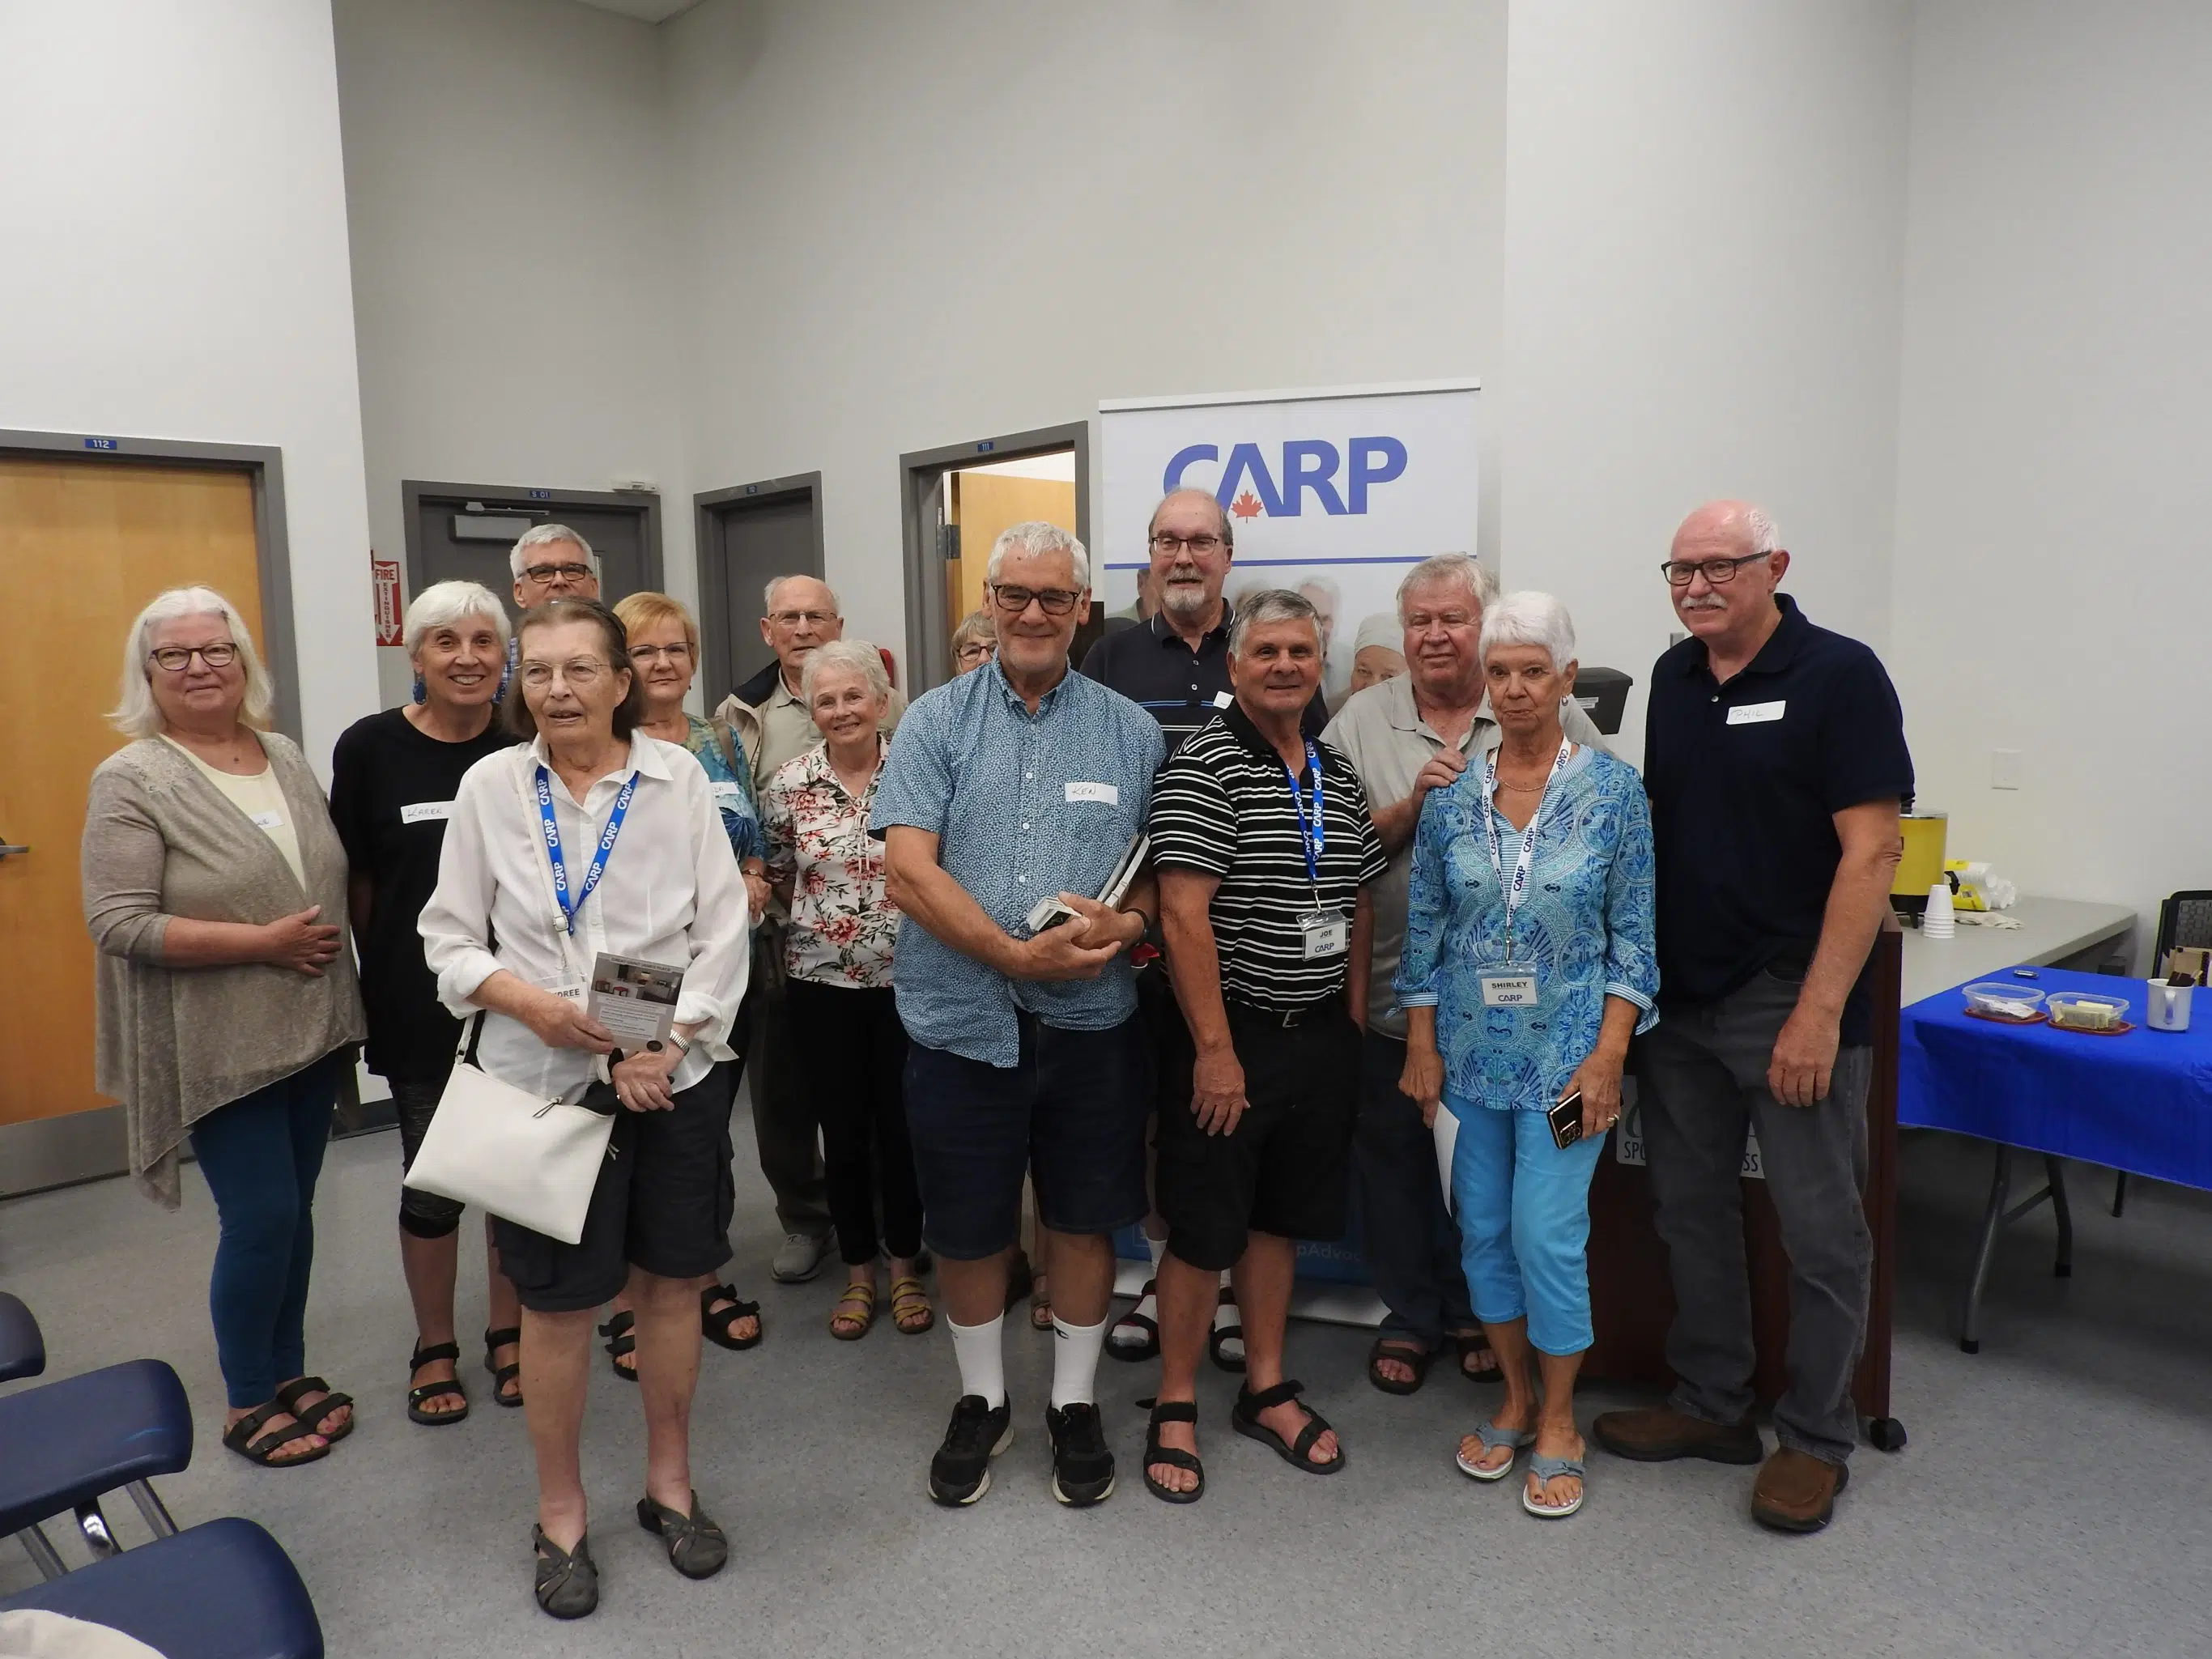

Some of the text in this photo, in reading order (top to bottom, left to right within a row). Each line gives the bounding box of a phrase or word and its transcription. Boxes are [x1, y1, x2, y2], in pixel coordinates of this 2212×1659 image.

[93, 440, 109, 449] 112
[1163, 436, 1407, 517] CARP
[376, 569, 395, 580] FIRE
[1556, 749, 1569, 770] CARP
[1312, 768, 1321, 790] CARP
[1485, 764, 1494, 784] CARP
[538, 779, 550, 806] CARP
[617, 782, 632, 810] CARP
[1072, 785, 1095, 795] KEN
[1313, 802, 1322, 827] CARP
[544, 819, 559, 847] CARP
[602, 821, 619, 850] CARP
[1523, 827, 1535, 853] CARP
[554, 861, 567, 891] CARP
[585, 861, 602, 891] CARP
[1513, 866, 1526, 891] CARP
[1320, 929, 1332, 938] JOE
[1315, 942, 1334, 953] CARP
